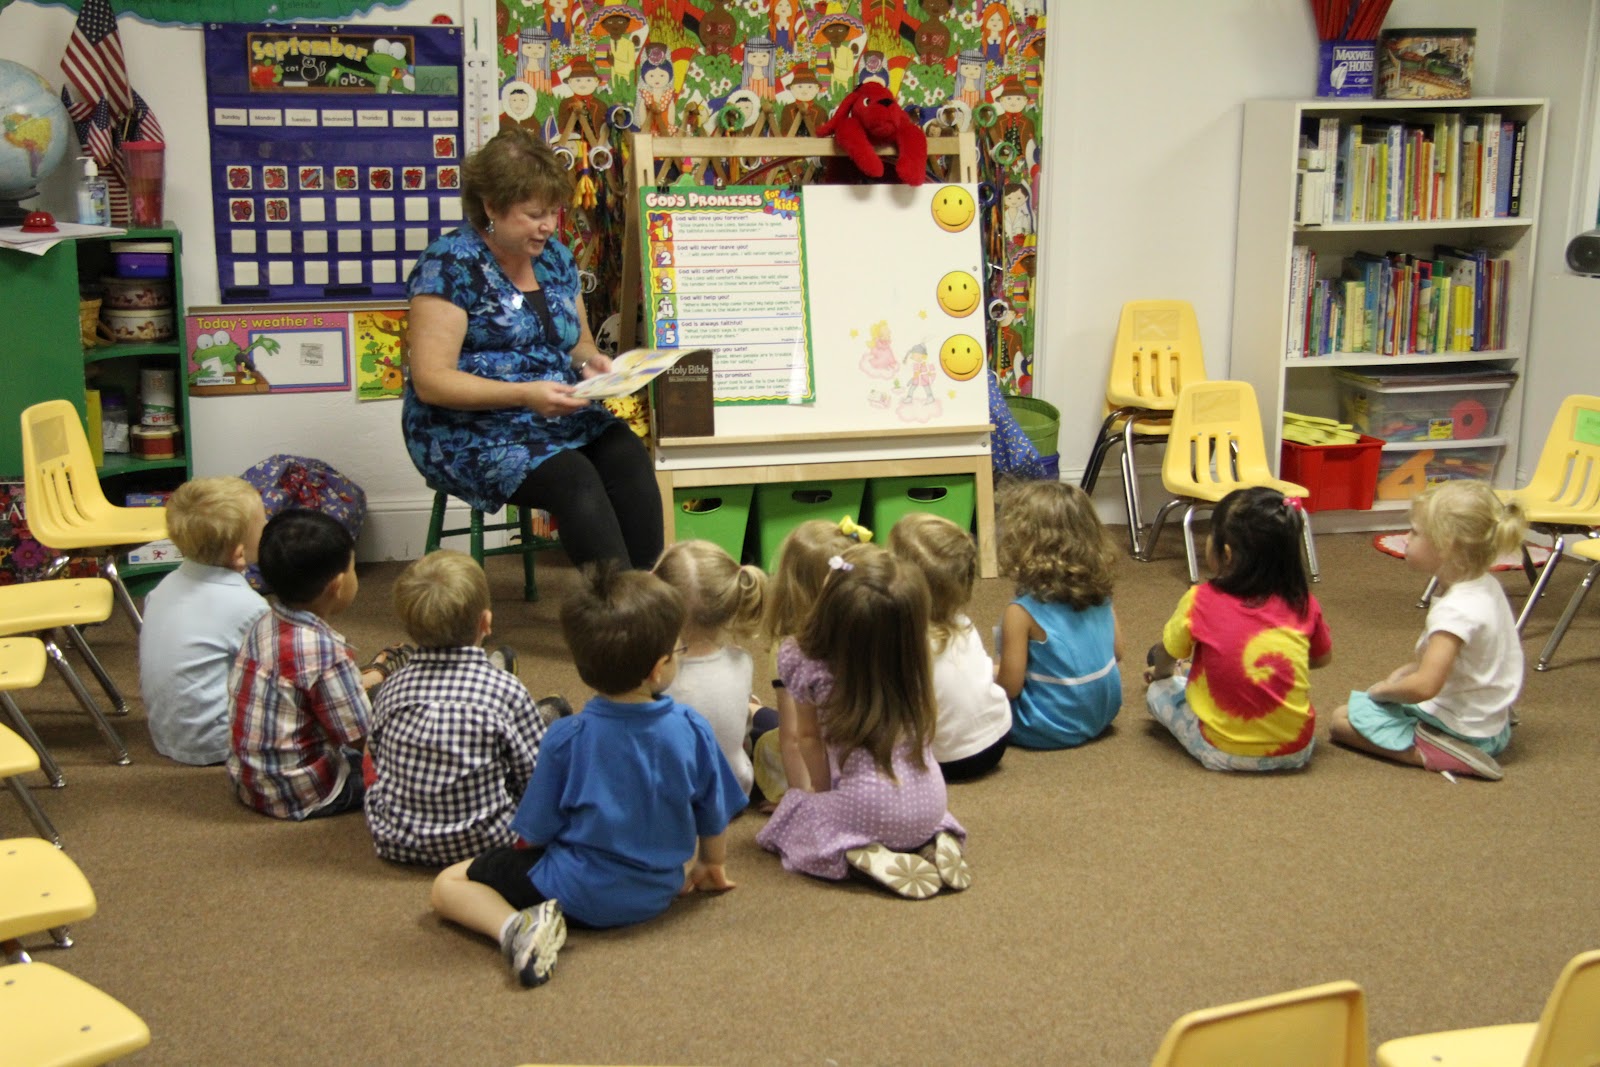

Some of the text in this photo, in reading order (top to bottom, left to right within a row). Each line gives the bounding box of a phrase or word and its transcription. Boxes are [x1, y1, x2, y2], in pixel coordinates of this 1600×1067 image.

[422, 76, 456, 93] 2012
[451, 142, 456, 157] 1
[242, 176, 251, 189] 2
[278, 175, 286, 188] 3
[313, 176, 322, 189] 4
[349, 176, 357, 189] 5
[382, 176, 391, 189] 6
[414, 175, 422, 188] 7
[450, 174, 458, 187] 8
[774, 198, 800, 211] Kids
[243, 207, 252, 220] 9
[272, 207, 288, 220] 10
[663, 225, 669, 238] 1
[660, 251, 672, 265] 2
[662, 278, 673, 291] 3
[196, 318, 248, 331] Today's
[251, 317, 309, 327] weather
[665, 330, 676, 344] 5
[666, 364, 709, 376] Holy Bible
